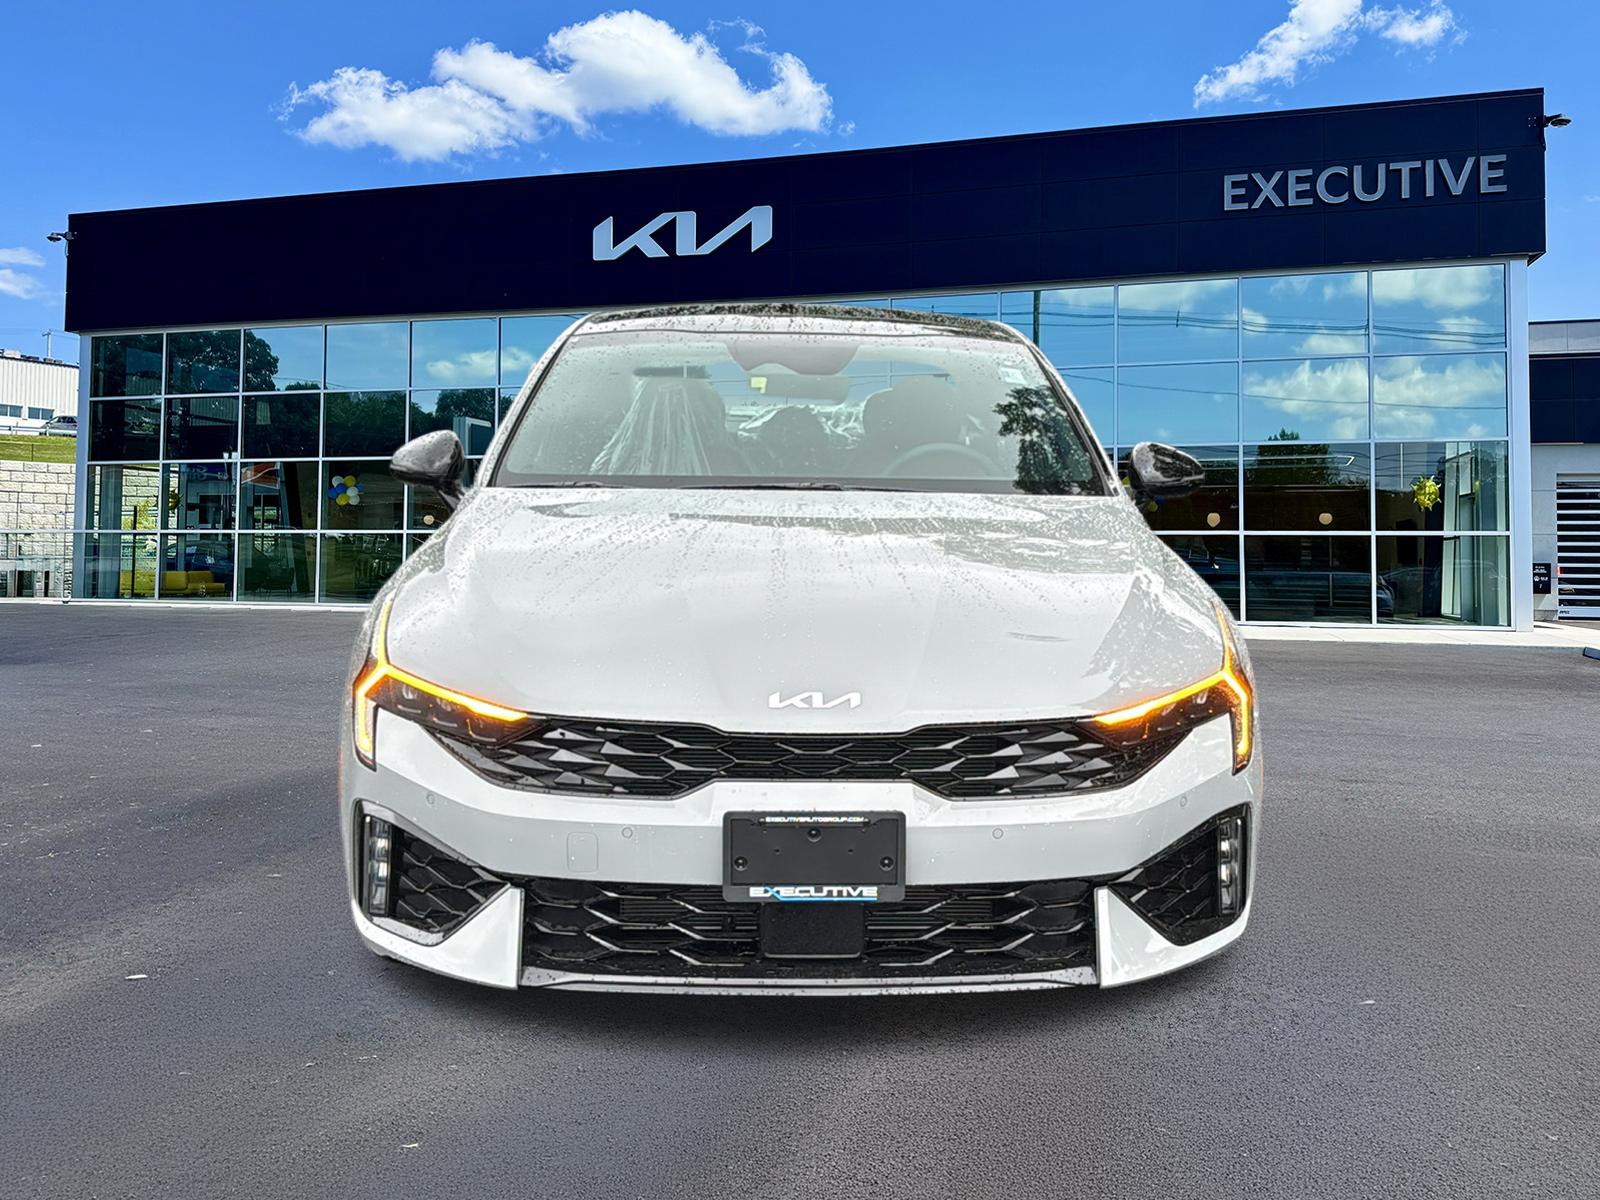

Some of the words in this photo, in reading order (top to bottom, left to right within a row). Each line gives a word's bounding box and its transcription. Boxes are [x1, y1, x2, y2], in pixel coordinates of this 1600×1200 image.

[1223, 154, 1508, 211] EXECUTIVE
[593, 205, 773, 261] KIA
[768, 691, 861, 709] KIA
[749, 886, 878, 900] EXECUTIVE
